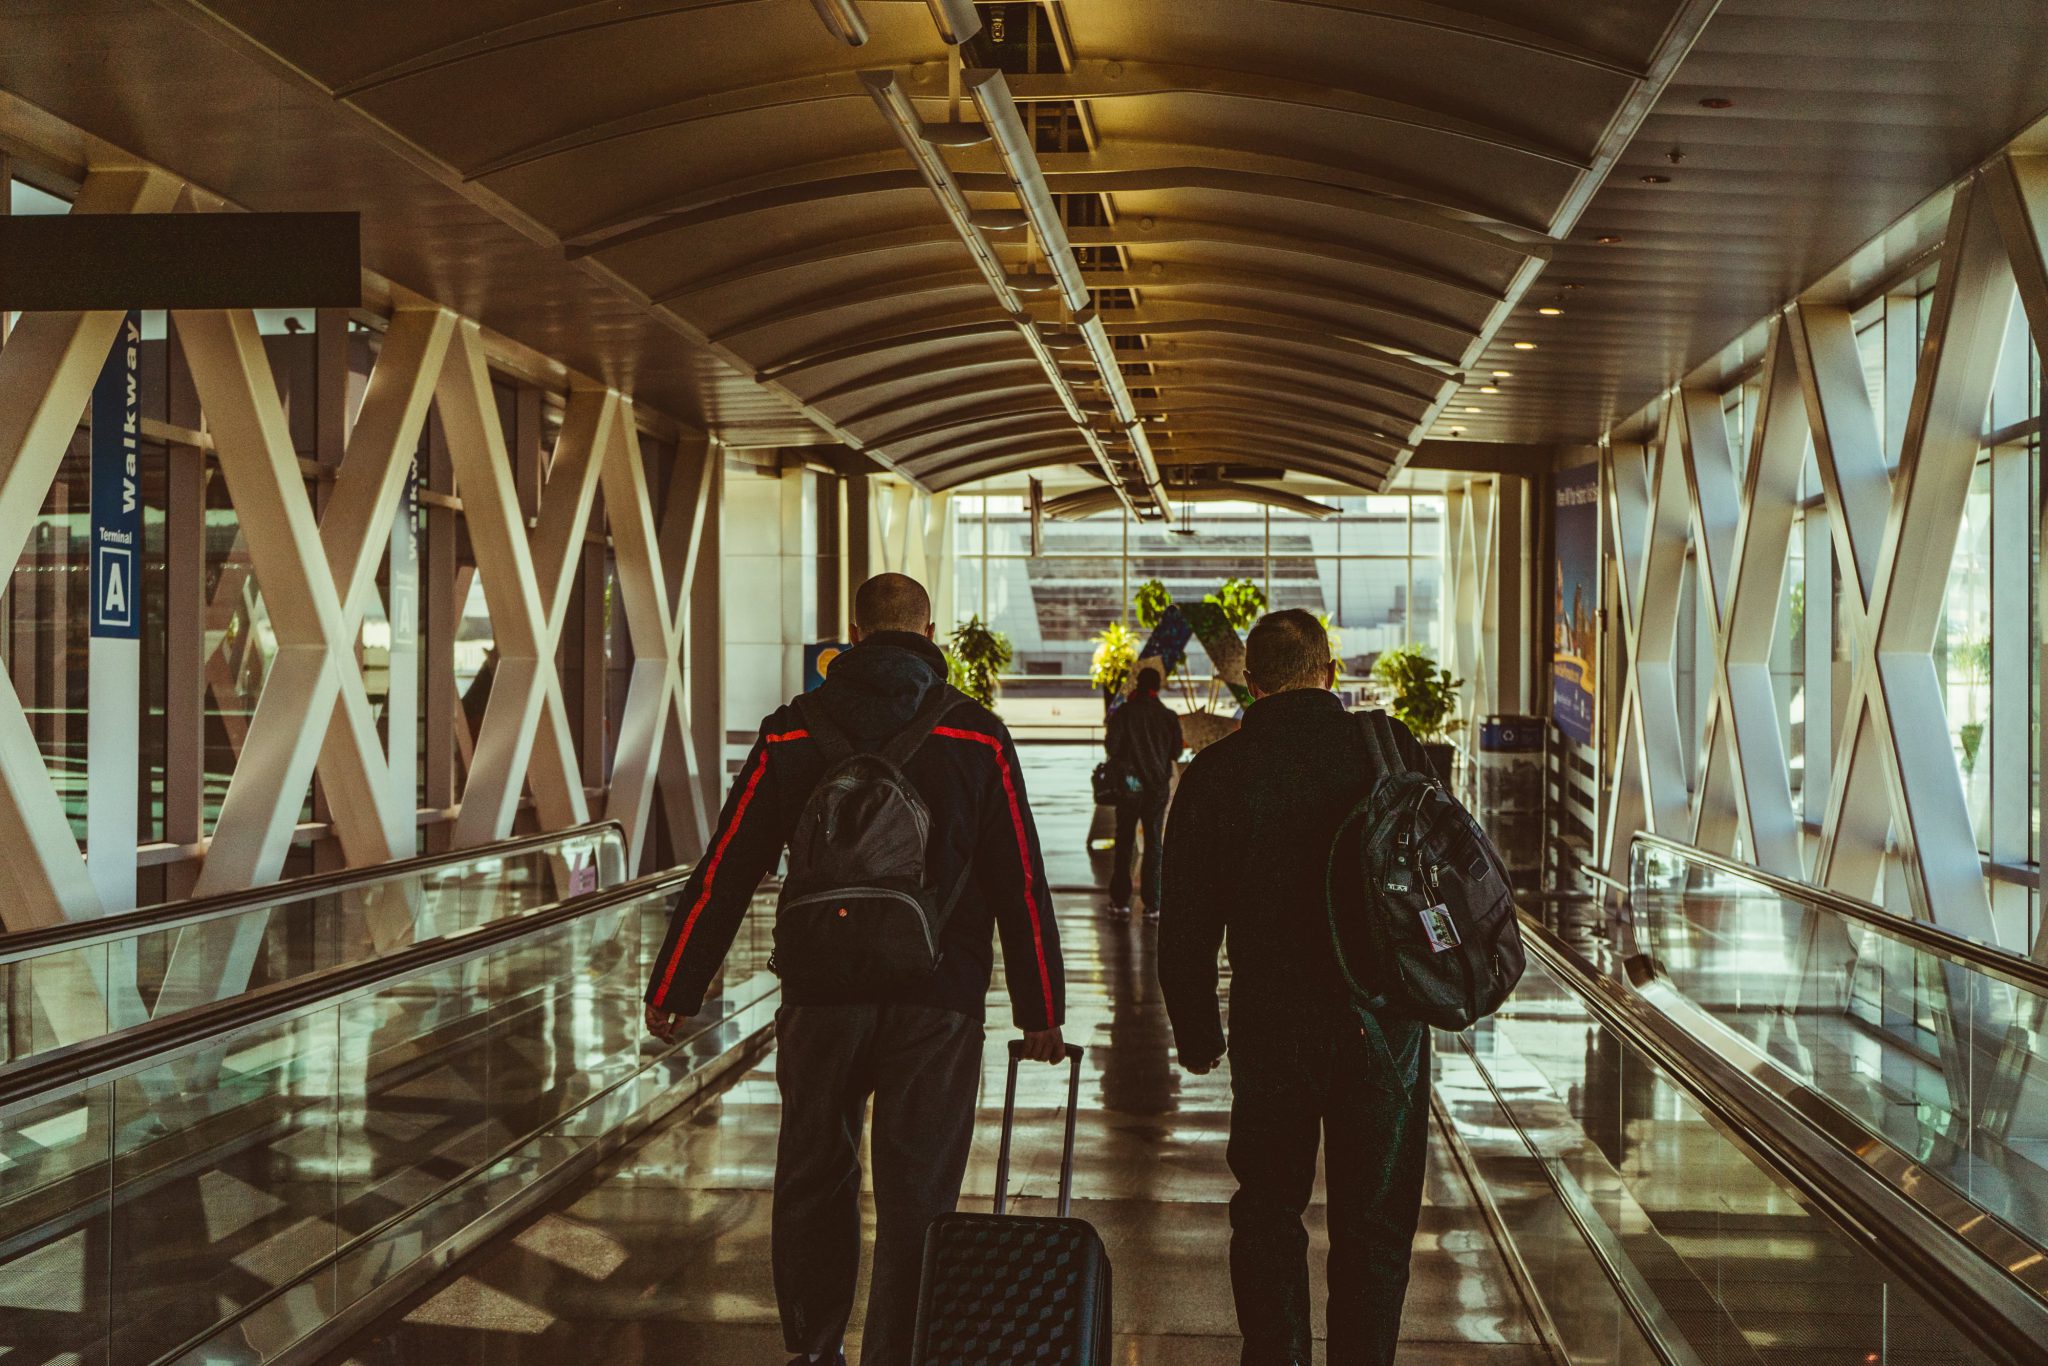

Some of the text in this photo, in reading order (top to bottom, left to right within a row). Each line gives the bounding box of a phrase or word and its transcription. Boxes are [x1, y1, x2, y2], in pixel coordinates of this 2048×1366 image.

[123, 320, 139, 514] walkway
[99, 526, 132, 545] Terminal
[105, 562, 126, 612] A
[399, 597, 411, 633] A
